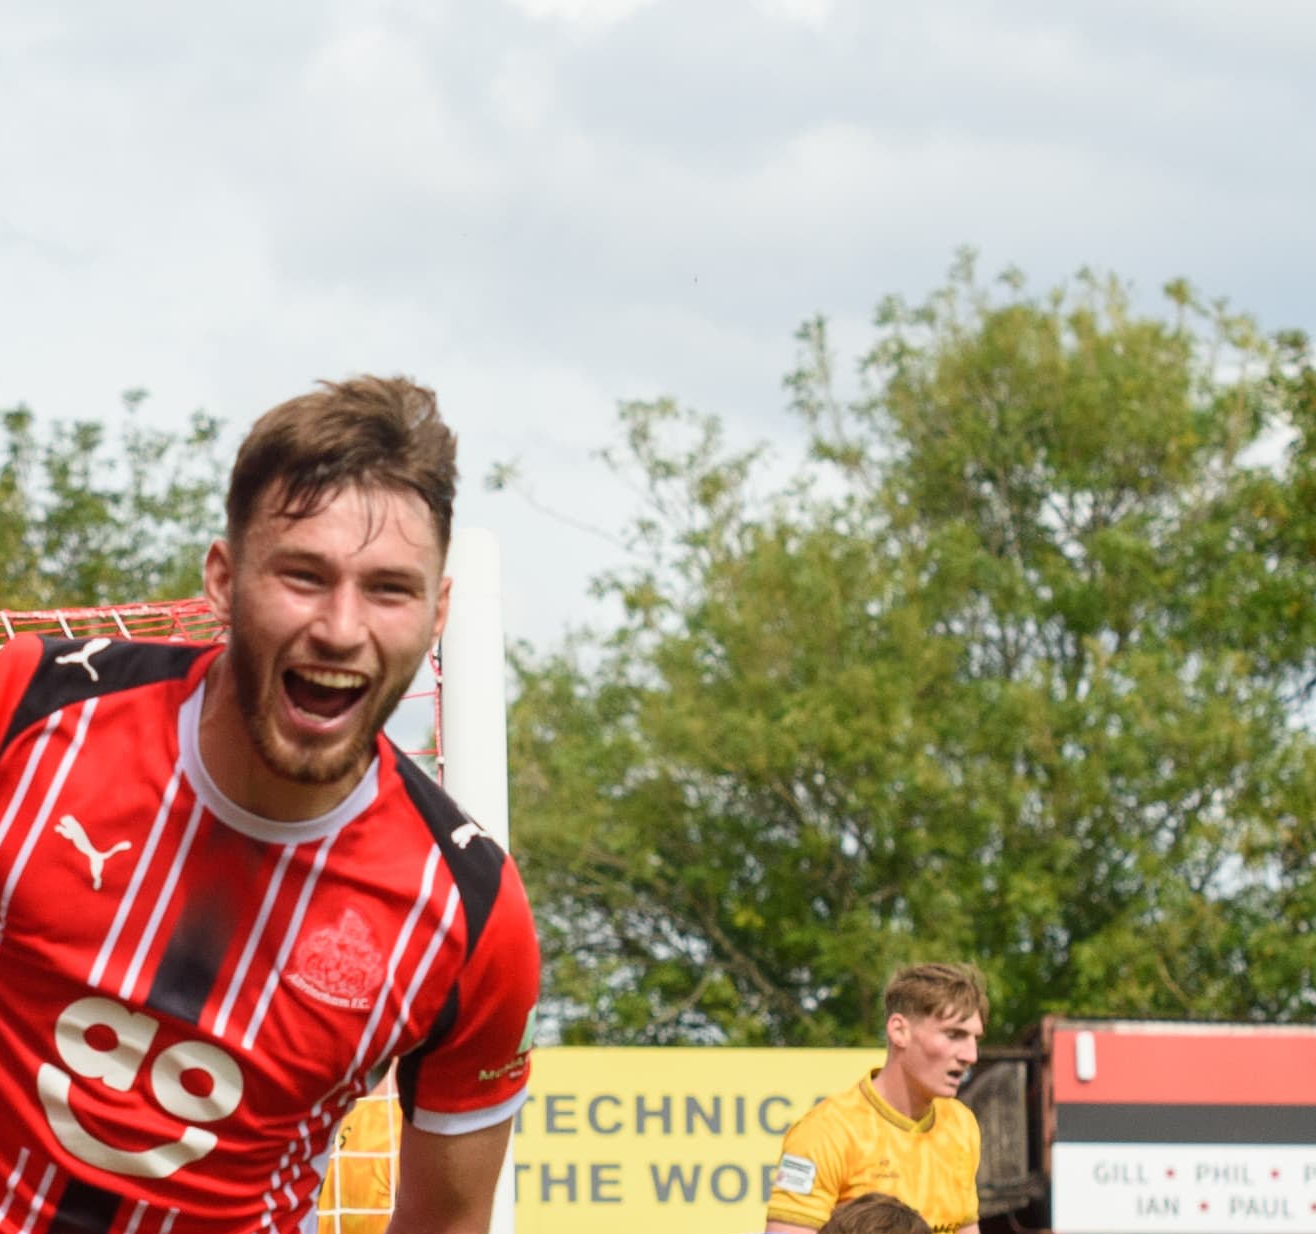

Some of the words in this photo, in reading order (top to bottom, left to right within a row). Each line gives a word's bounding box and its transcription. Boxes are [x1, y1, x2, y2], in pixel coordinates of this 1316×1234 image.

[514, 1095, 831, 1136] TECHNIC
[514, 1163, 624, 1203] THE
[1093, 1162, 1149, 1186] GILL
[1195, 1163, 1252, 1186] PHIL
[1137, 1196, 1180, 1217] IAN
[1229, 1196, 1293, 1218] PAUL
